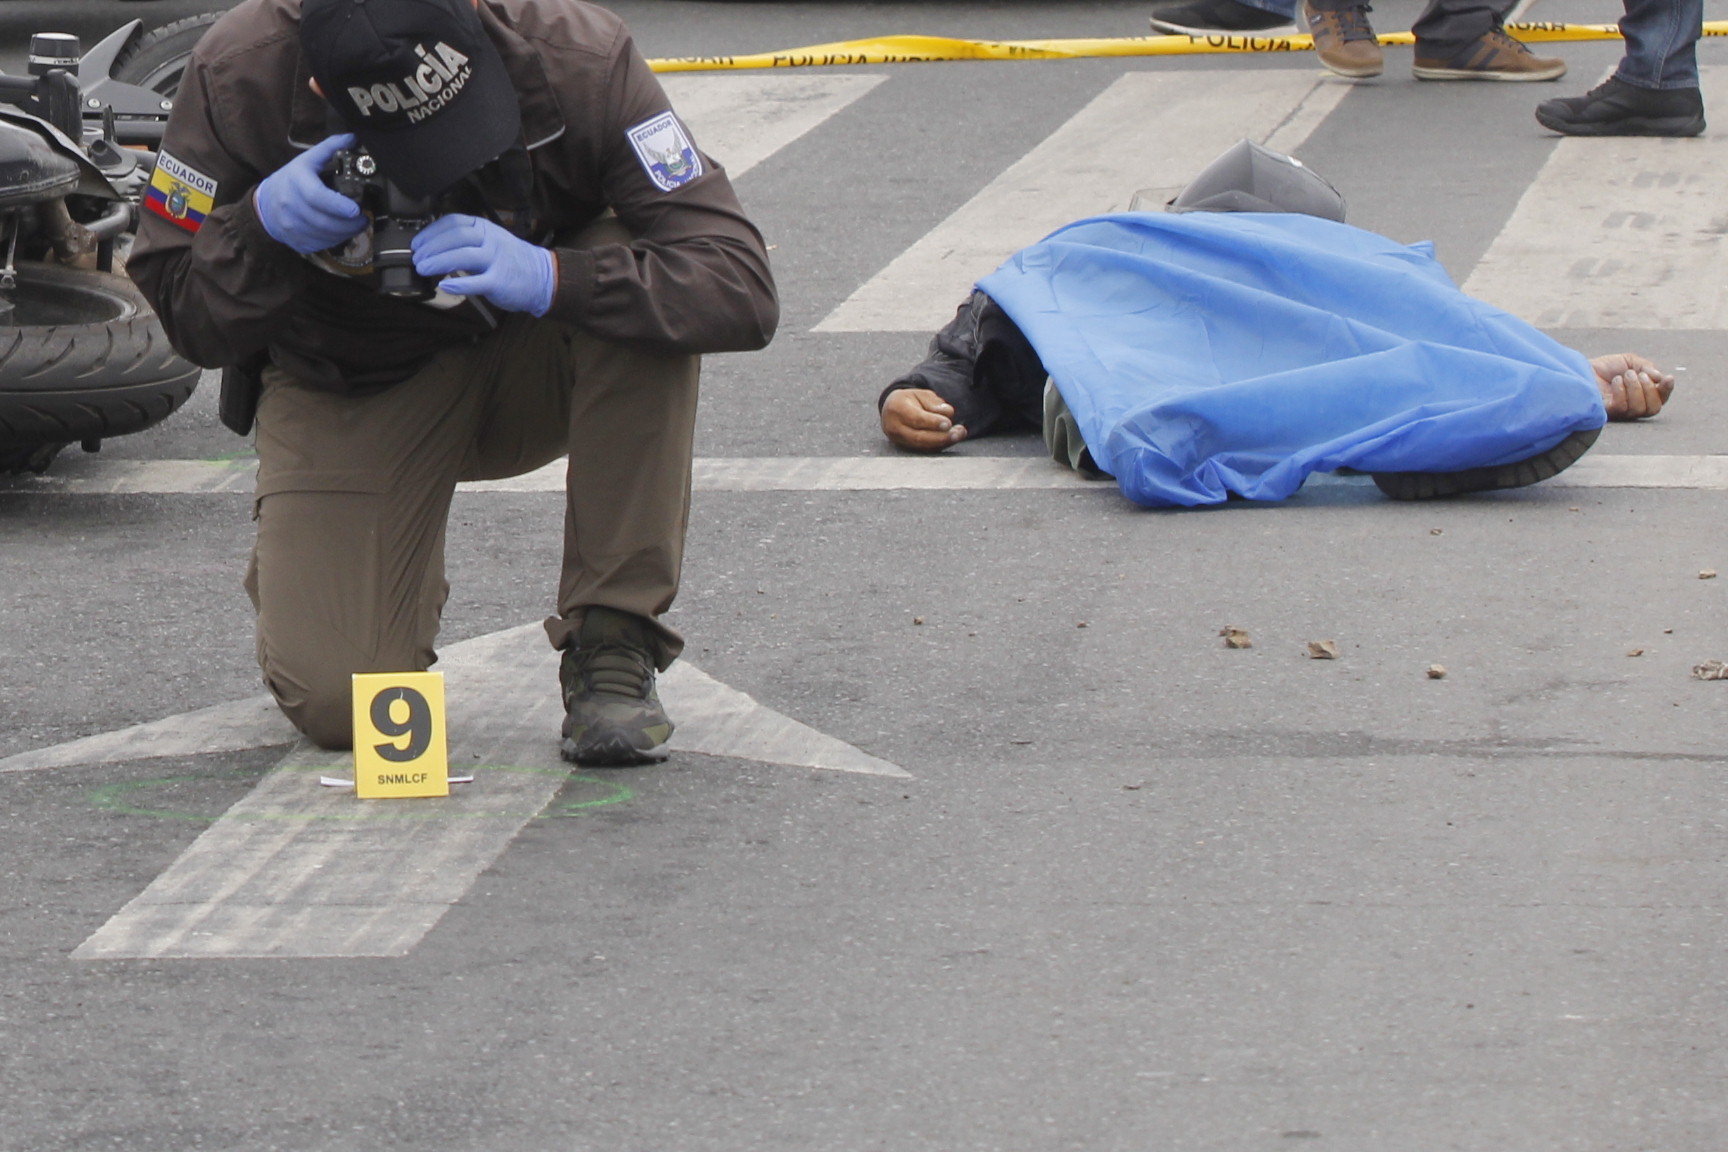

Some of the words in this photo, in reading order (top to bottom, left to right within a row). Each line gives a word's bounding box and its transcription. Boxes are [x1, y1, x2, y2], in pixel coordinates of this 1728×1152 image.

[347, 41, 469, 116] POLICÍA
[407, 65, 472, 125] NACIONAL
[636, 119, 672, 142] ECUADOR
[159, 155, 214, 193] ECUADOR
[370, 686, 432, 762] 9
[377, 773, 428, 785] SNMLCF
